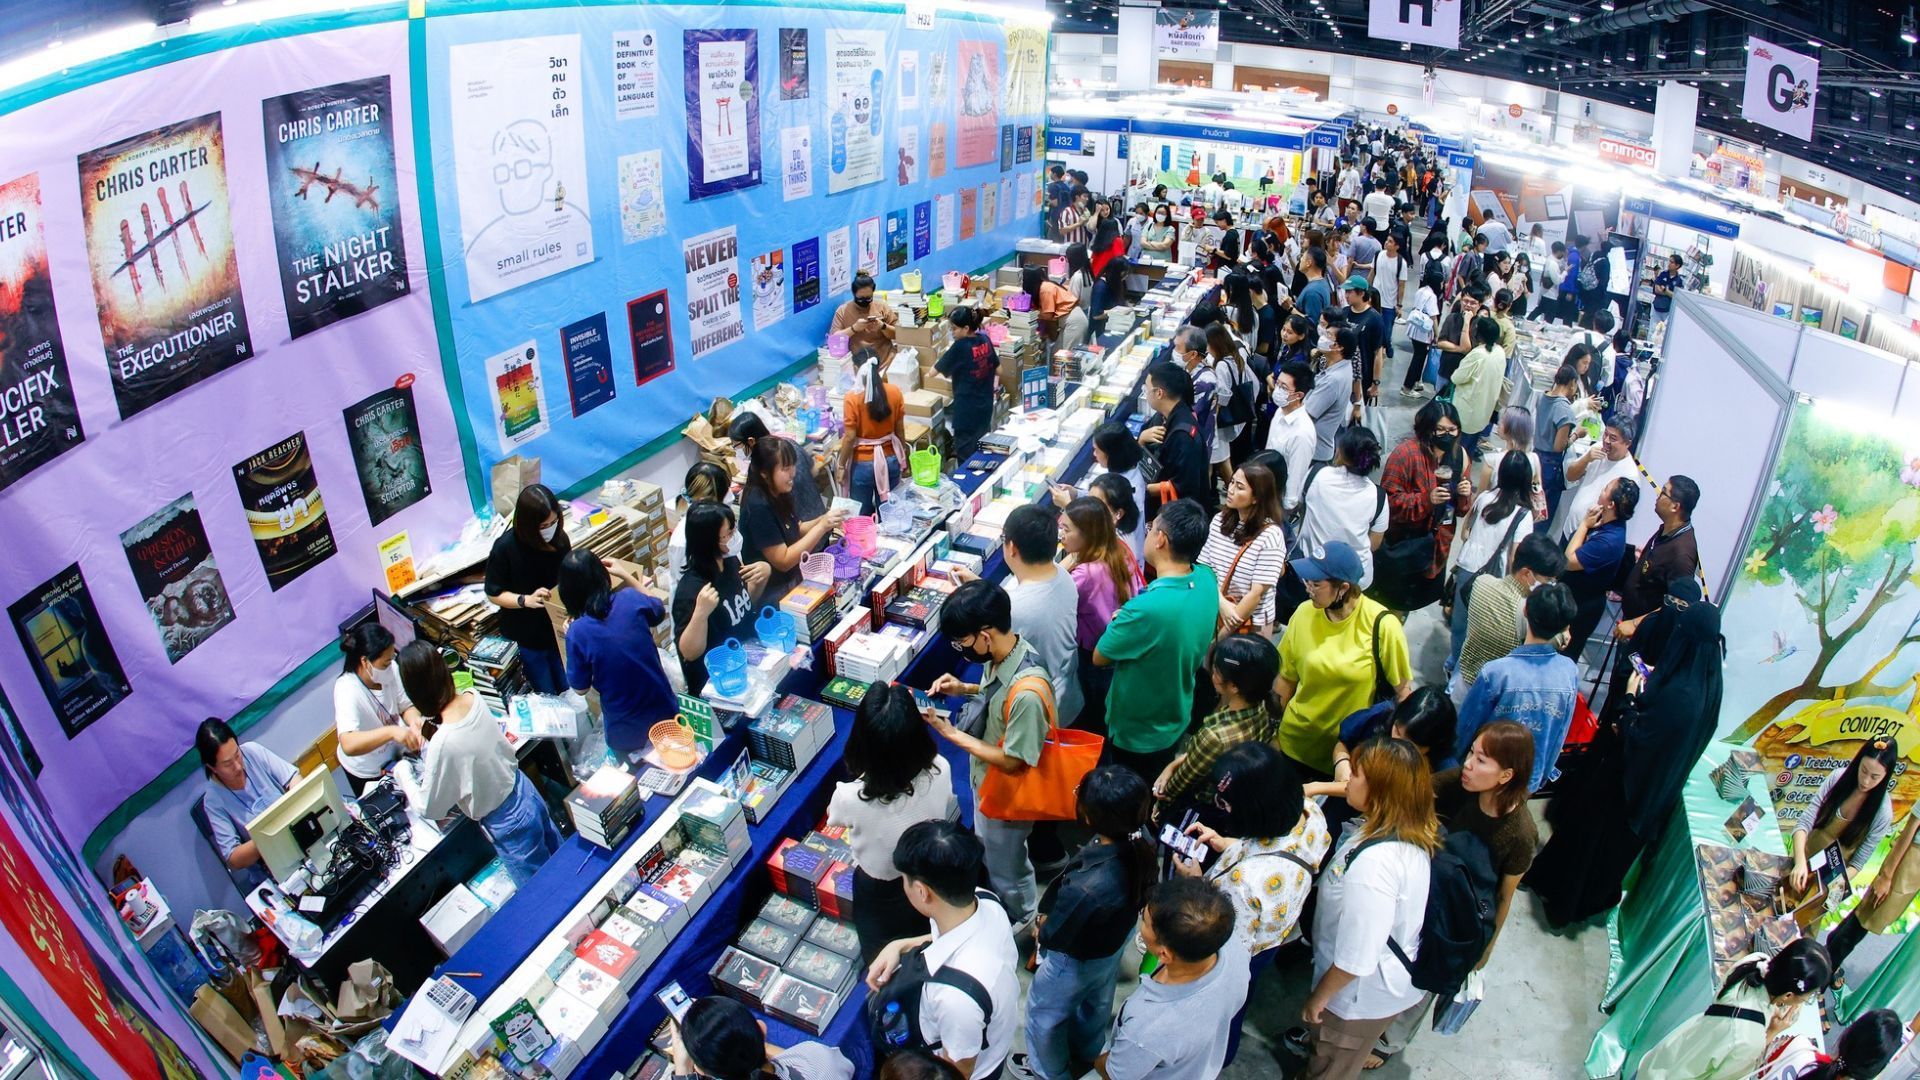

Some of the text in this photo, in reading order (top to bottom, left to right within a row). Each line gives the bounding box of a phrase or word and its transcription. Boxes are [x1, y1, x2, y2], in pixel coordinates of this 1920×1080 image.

[917, 13, 932, 26] H32
[1168, 30, 1205, 41] หนังสือเก่า
[549, 56, 568, 69] วิชา
[616, 49, 654, 59] DEFINITIVE
[616, 61, 636, 70] BOOK
[551, 73, 566, 83] คน
[617, 72, 627, 80] OF
[552, 87, 567, 100] ตัว
[617, 83, 636, 91] BODY
[1767, 64, 1795, 113] G
[618, 91, 655, 102] LANGUAGE
[551, 103, 569, 118] เล็ก
[278, 116, 321, 143] CHRIS
[326, 104, 380, 132] CARTER
[1055, 136, 1073, 146] H32
[1318, 136, 1332, 145] H30
[1454, 157, 1469, 165] H27
[1600, 140, 1655, 166] animag
[96, 146, 209, 202] CHRIS CARTER
[789, 160, 805, 172] HARD
[787, 171, 808, 186] THINGS
[1820, 174, 1826, 182] 5
[292, 226, 390, 276] THE NIGHT
[496, 249, 530, 270] small
[532, 241, 562, 259] rules
[684, 236, 738, 274] NEVER
[296, 251, 395, 304] STALKER
[688, 293, 719, 322] SPLIT
[720, 284, 741, 308] THE
[702, 311, 731, 327] CHRIS VOSS
[119, 311, 237, 380] EXECUTIONER
[570, 328, 597, 345] INVISIBLE
[571, 334, 602, 352] INFLUENCE
[691, 319, 745, 356] DIFFERENCE
[117, 344, 134, 359] THE
[355, 398, 405, 428] CHRIS CARTER
[0, 405, 47, 453] LER
[249, 436, 302, 470] JACK REACHER
[258, 480, 298, 507] หยุดชีพจร
[381, 479, 416, 505] SCULPTOR
[40, 573, 81, 602] WRONG PLACE
[48, 582, 83, 608] WRONG TIME
[723, 588, 751, 626] Lee
[1840, 717, 1904, 738] CONTACT
[786, 848, 805, 868] ONLY
[795, 853, 812, 869] ONE
[803, 855, 821, 873] LEFT
